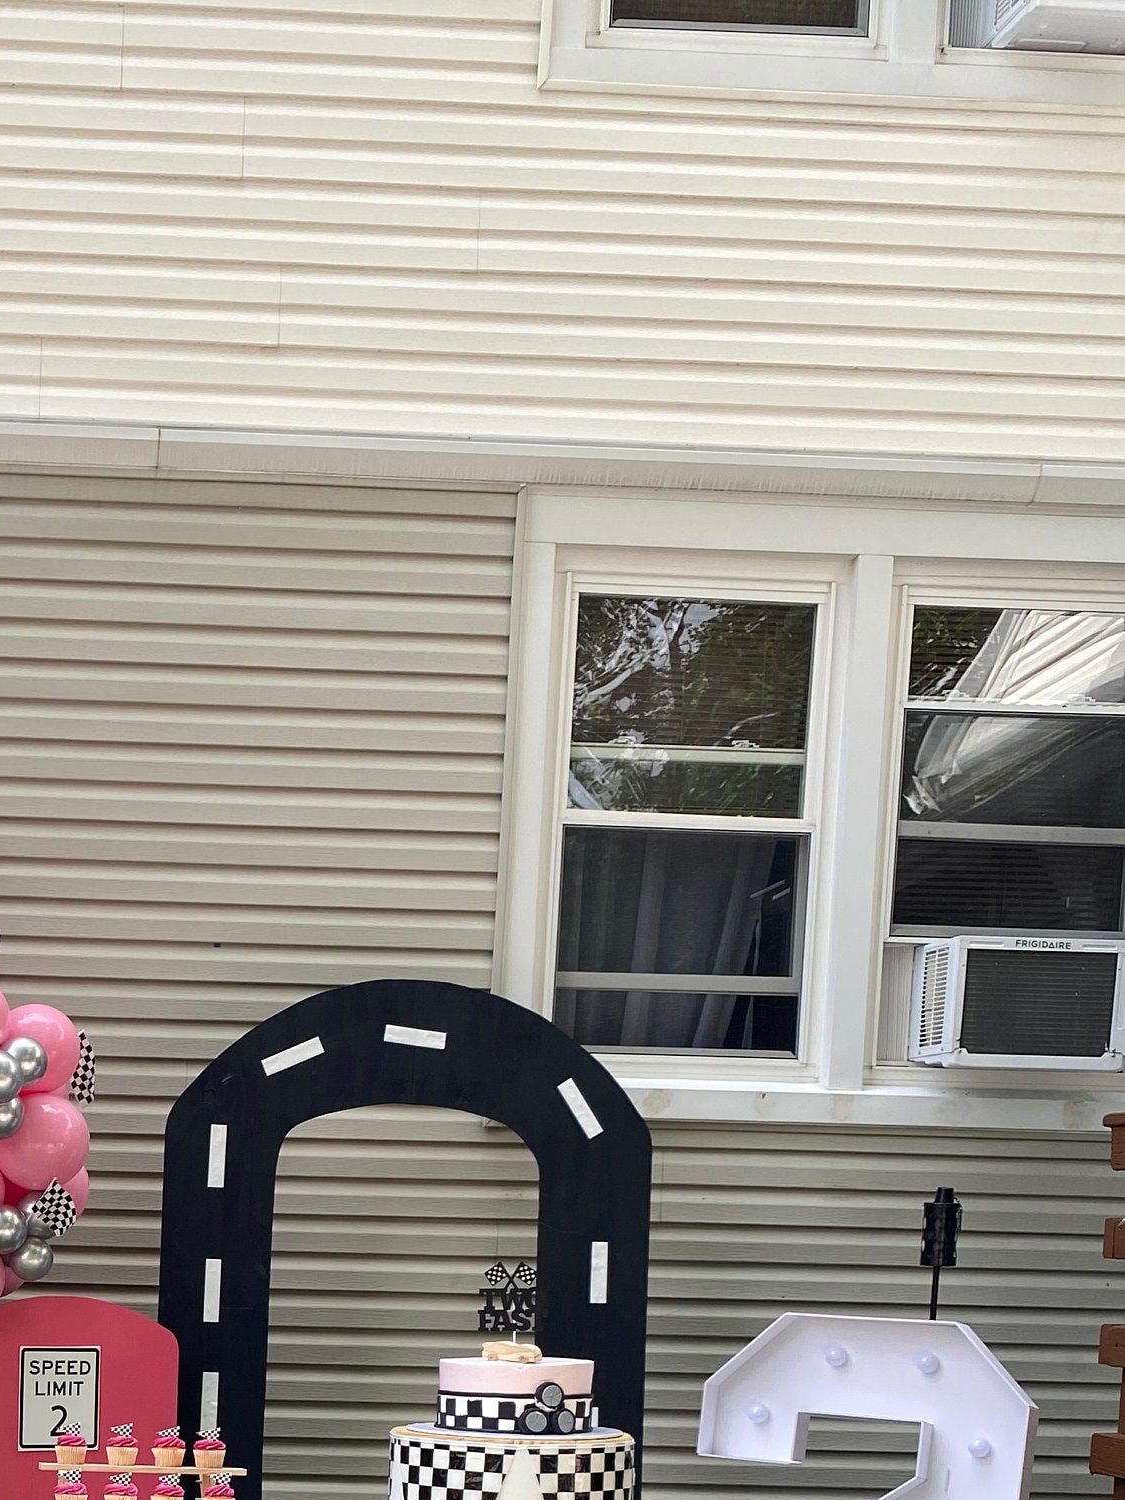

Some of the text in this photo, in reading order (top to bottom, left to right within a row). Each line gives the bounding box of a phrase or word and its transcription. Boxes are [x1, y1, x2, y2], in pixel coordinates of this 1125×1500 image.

[1015, 939, 1072, 950] FRIGIDAIRE
[478, 1310, 537, 1332] FAS
[29, 1360, 91, 1376] SPEED
[35, 1381, 84, 1396] LIMIT
[50, 1405, 68, 1437] 2
